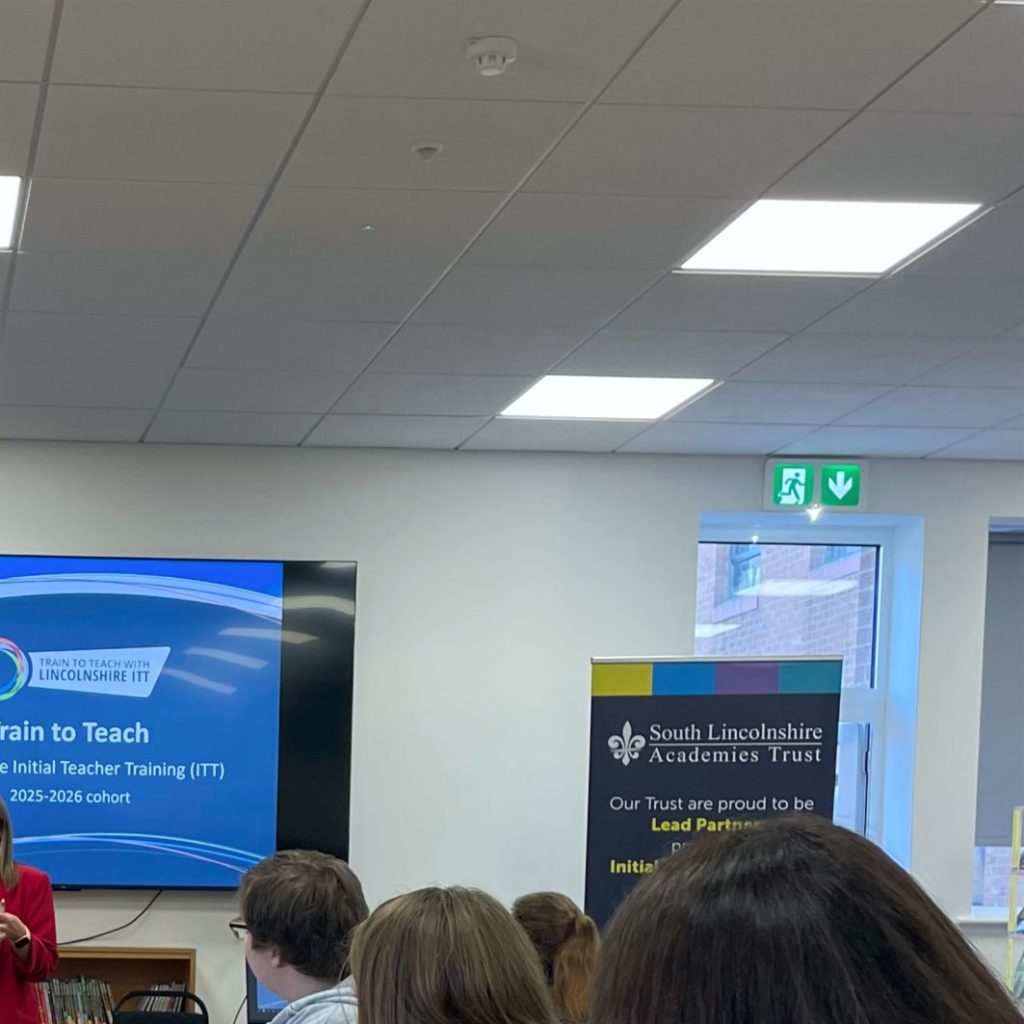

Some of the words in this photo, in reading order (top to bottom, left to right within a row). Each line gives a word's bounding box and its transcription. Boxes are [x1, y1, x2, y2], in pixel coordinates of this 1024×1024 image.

[39, 658, 69, 668] TRAIN
[73, 658, 87, 668] TO
[90, 658, 121, 669] TEACH
[124, 660, 150, 669] WITH
[39, 668, 127, 682] LINCOLNSHIRE
[132, 671, 150, 683] ITT
[51, 722, 76, 742] to
[83, 722, 150, 744] Teach
[649, 724, 702, 741] South
[707, 722, 823, 741] Lincolnshire
[648, 746, 760, 763] Academies
[768, 746, 822, 762] Trust
[12, 758, 56, 775] Initial
[59, 760, 120, 776] Teacher
[125, 761, 186, 779] Training
[190, 762, 225, 780] (ITT)
[9, 789, 83, 803] 2025-2026
[86, 791, 131, 804] cohort
[609, 796, 641, 811] Our
[645, 796, 683, 811] Trust
[688, 799, 713, 811] are
[718, 796, 767, 814] proud
[772, 798, 789, 811] to
[794, 796, 815, 811] be
[651, 818, 692, 832] Lead
[610, 859, 659, 874] Initia
